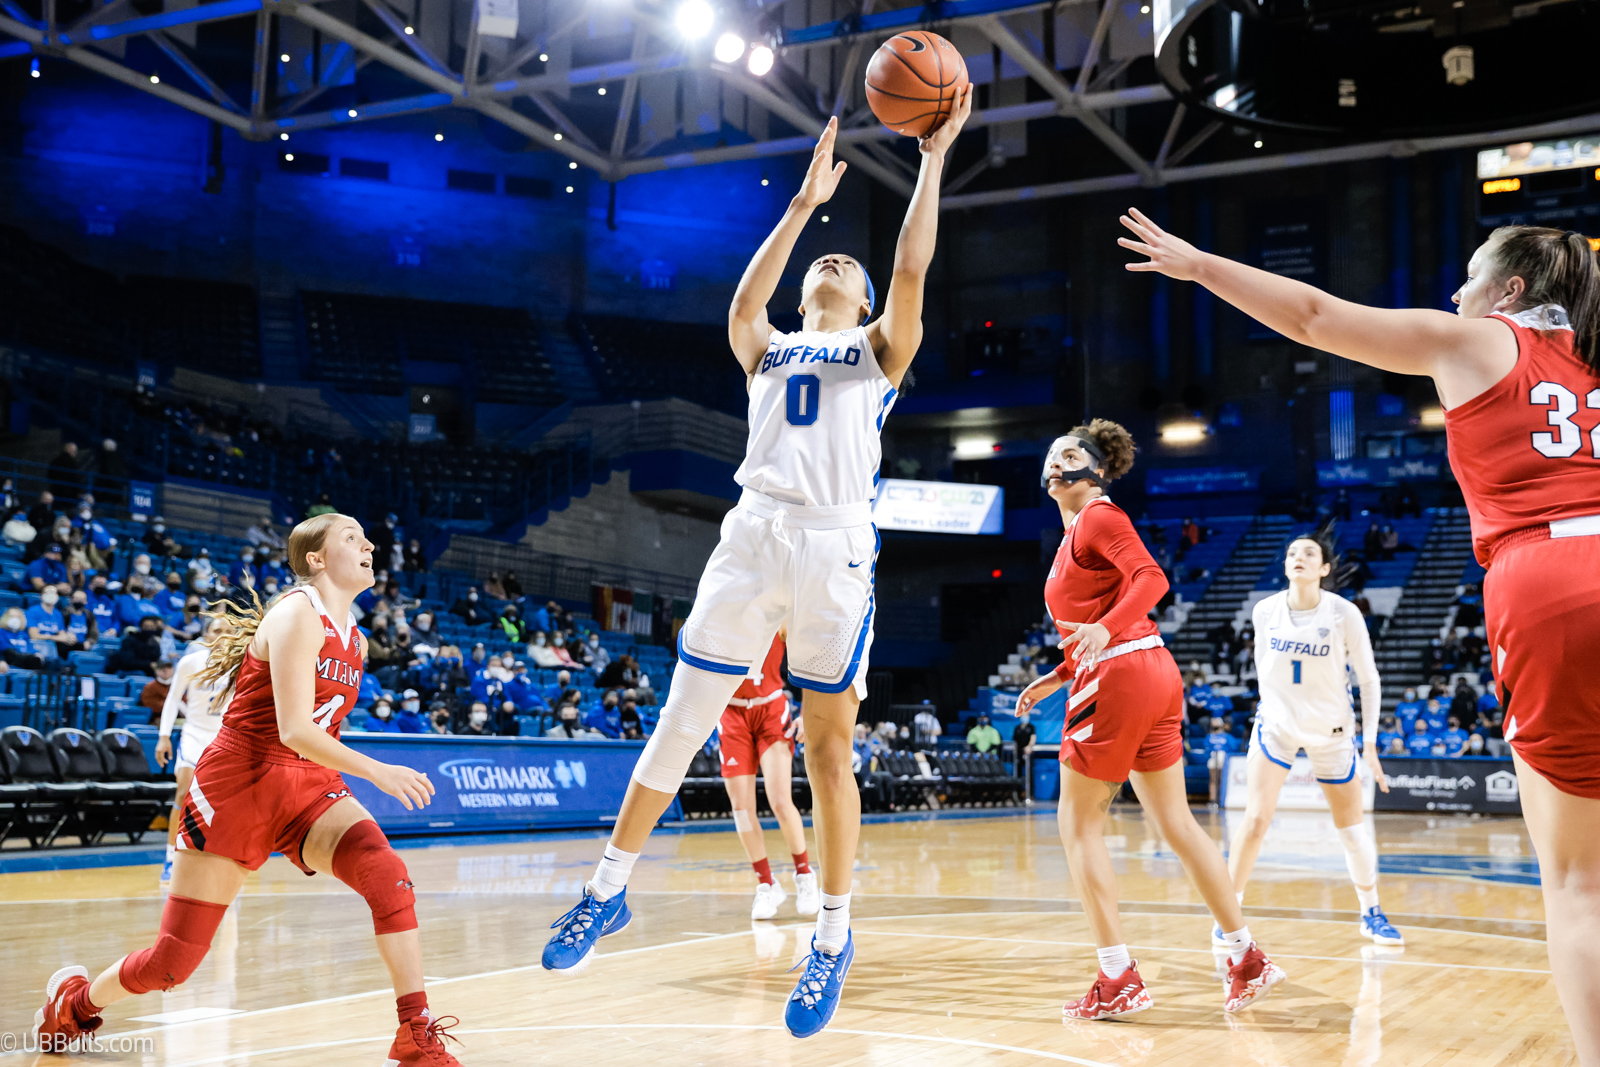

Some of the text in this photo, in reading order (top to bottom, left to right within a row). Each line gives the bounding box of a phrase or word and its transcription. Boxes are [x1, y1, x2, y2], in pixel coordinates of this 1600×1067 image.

[761, 345, 861, 375] BUFFALO
[784, 373, 822, 428] 0
[1529, 380, 1600, 460] 3
[1270, 637, 1330, 657] BUFFALO
[316, 655, 361, 691] MIAM
[1290, 659, 1302, 685] 1
[451, 765, 556, 790] HIGHMARK
[457, 792, 560, 808] WESTERN NEW YORK
